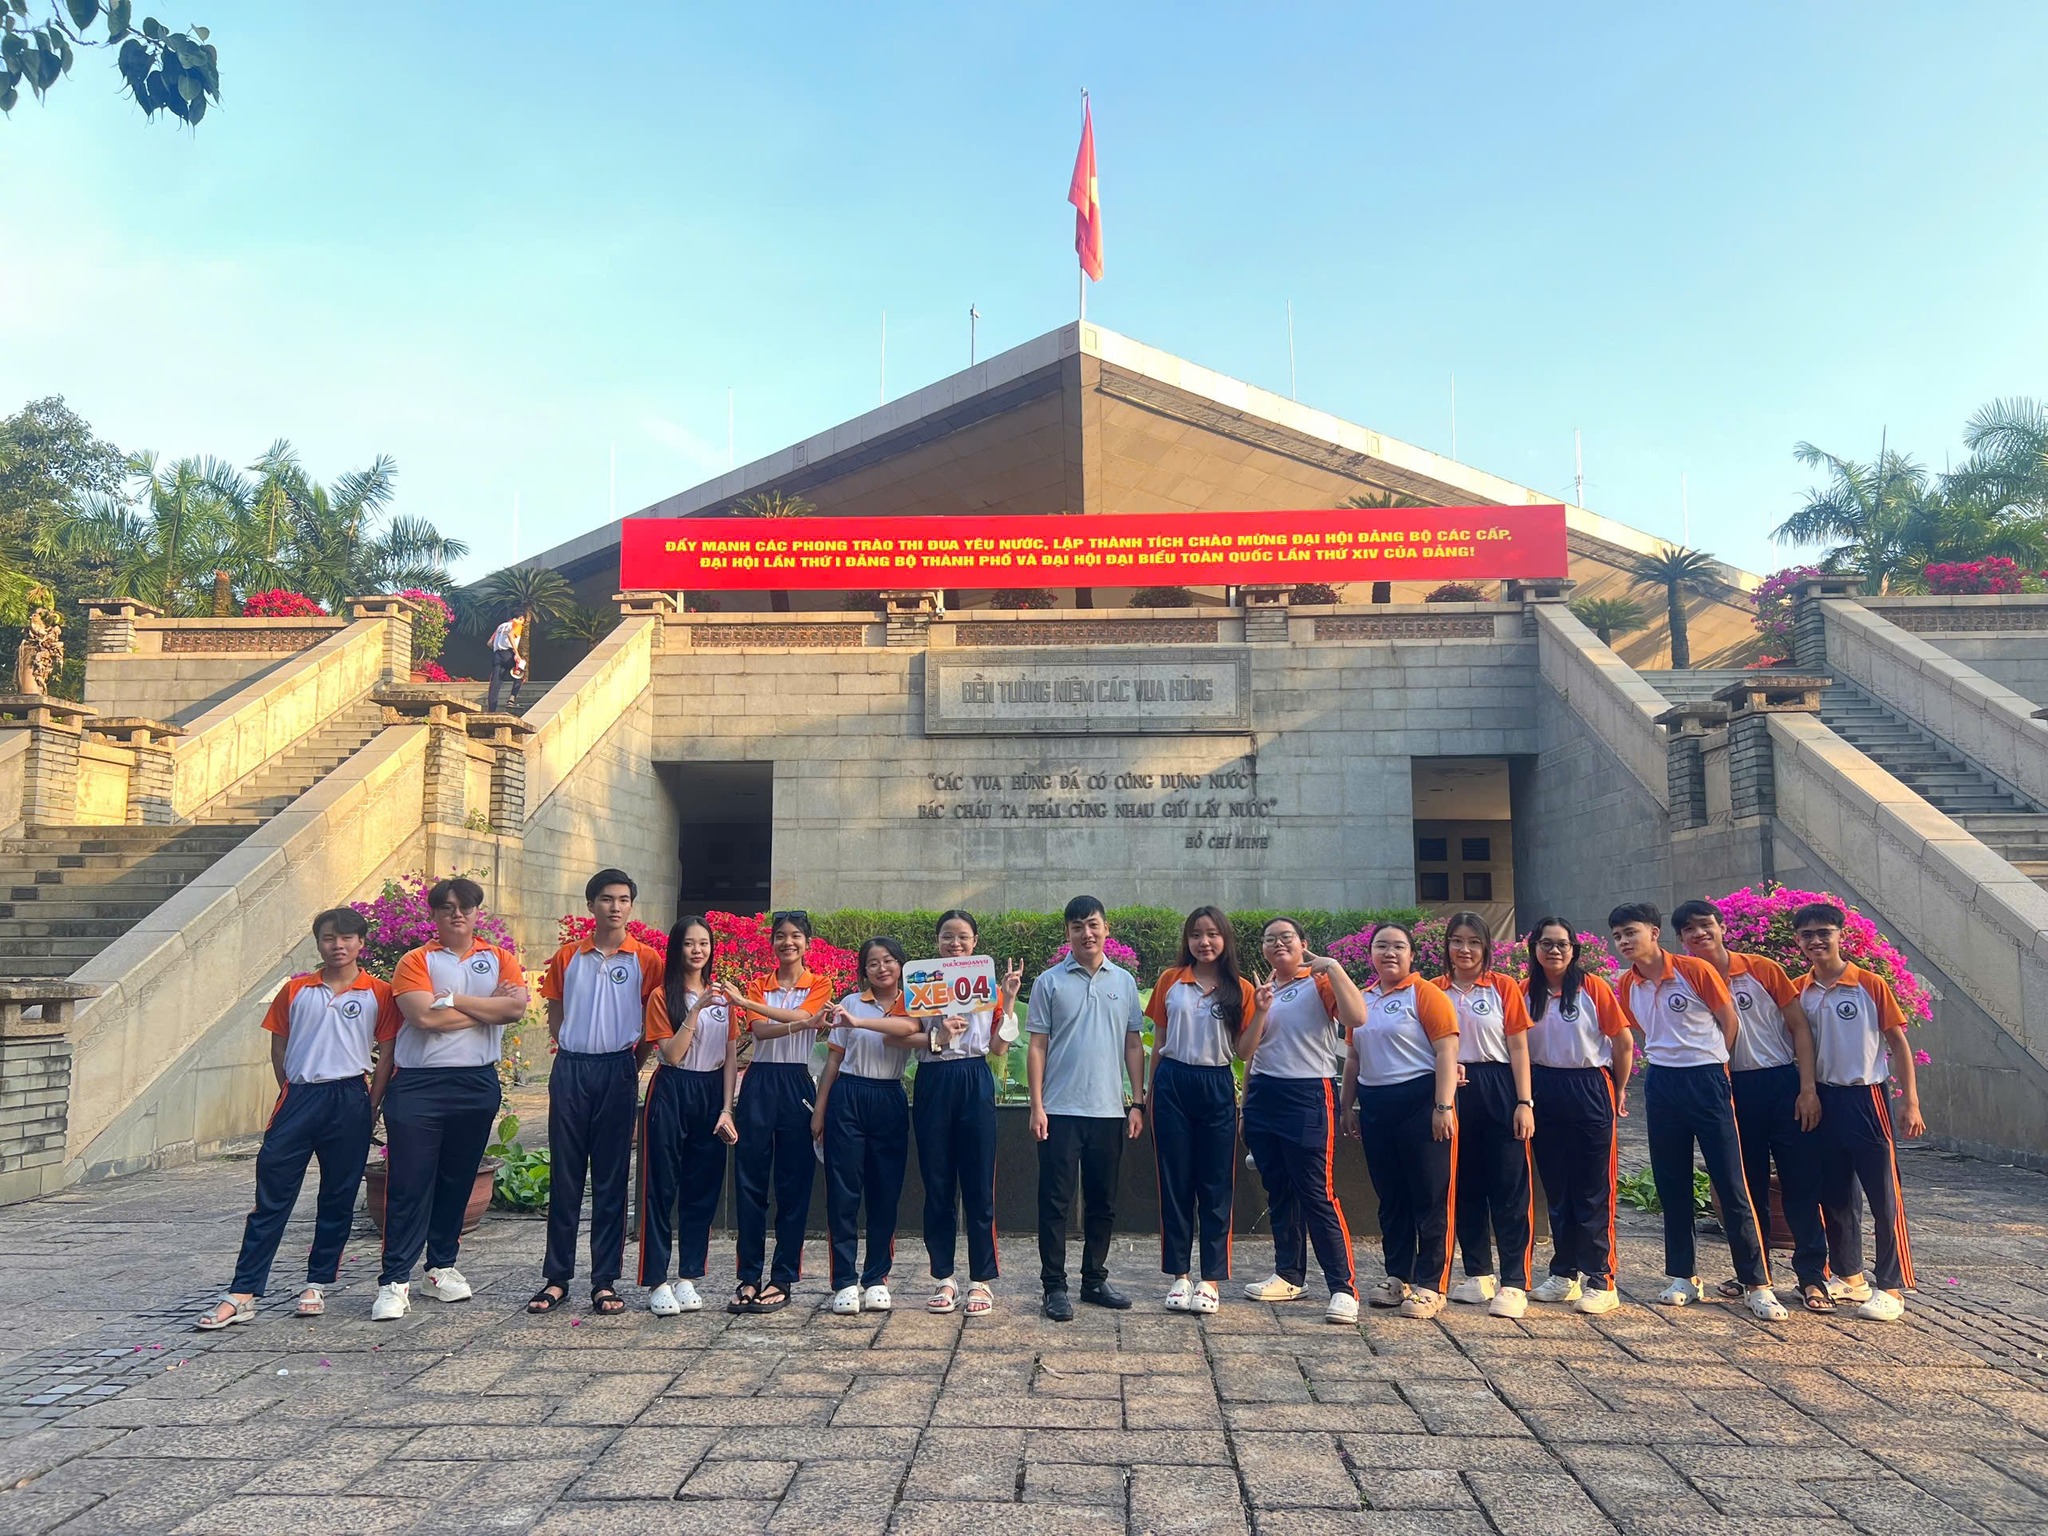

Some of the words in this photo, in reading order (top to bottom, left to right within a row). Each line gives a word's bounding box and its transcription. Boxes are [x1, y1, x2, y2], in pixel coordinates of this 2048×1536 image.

[664, 537, 698, 552] ĐẨY
[701, 541, 751, 554] MẠNH
[754, 539, 788, 553] CÁC
[792, 540, 848, 552] PHONG
[851, 538, 894, 551] TRÀO
[897, 539, 924, 551] THI
[927, 539, 960, 551] ĐUA
[963, 537, 995, 551] YÊU
[998, 536, 1049, 551] NƯỚC,
[1053, 536, 1085, 552] LẬP
[1087, 535, 1143, 549] THÀNH
[1146, 535, 1184, 549] TÍCH
[1187, 533, 1233, 548] CHÀO
[1236, 532, 1288, 547] MỪNG
[1291, 533, 1321, 549] ĐẠI
[1324, 530, 1354, 546] HỘI
[1357, 529, 1405, 545] ĐẢNG
[1408, 528, 1433, 544] BỘ
[1436, 528, 1472, 543] CÁC
[1475, 527, 1513, 542] CẤP,
[699, 557, 728, 570] ĐẠI
[731, 555, 760, 570] HỘI
[763, 554, 796, 568] LẦN
[799, 554, 833, 568] THỨ
[835, 556, 841, 568] I
[844, 553, 891, 568] ĐẢNG
[894, 553, 917, 569] BỘ
[920, 553, 975, 567] THÀNH
[978, 551, 1012, 567] PHỐ
[1015, 552, 1038, 566] VÀ
[1041, 554, 1070, 568] ĐẠI
[1073, 552, 1102, 568] HỘI
[1105, 553, 1134, 567] ĐẠI
[1138, 549, 1177, 565] BIỂU
[1179, 550, 1225, 564] TOÀN
[1228, 548, 1274, 564] QUỐC
[1277, 547, 1311, 562] LẦN
[1314, 546, 1349, 561] THỨ
[1351, 547, 1380, 560] XIV
[1383, 545, 1419, 559] CỦA
[1421, 544, 1476, 559] ĐẢNG!
[961, 673, 995, 704] ĐỀN
[1053, 675, 1095, 706] NIỆM
[1097, 675, 1130, 702] CÁC
[1133, 679, 1166, 702] VUA
[1169, 674, 1214, 702] HÙNG
[972, 774, 1003, 791] VUA
[1011, 771, 1052, 791] HÙNG
[1088, 770, 1108, 790] CÓ
[1114, 771, 1154, 790] CÔNG
[1160, 771, 1202, 793] DỰNG
[1209, 768, 1249, 790] NƯỚC
[917, 799, 945, 819] BÁC
[953, 798, 993, 819] CHÁU
[1001, 804, 1019, 819] TA
[1027, 797, 1062, 819] PHẢI
[1069, 798, 1109, 819] CÙNG
[1115, 803, 1155, 819] NHAU
[1195, 797, 1221, 818] LẤY
[1184, 829, 1204, 849] HỒ
[1208, 832, 1233, 849] CHÍ
[1234, 836, 1269, 849] MINH
[908, 982, 948, 1007] XE
[954, 975, 991, 1001] 04
